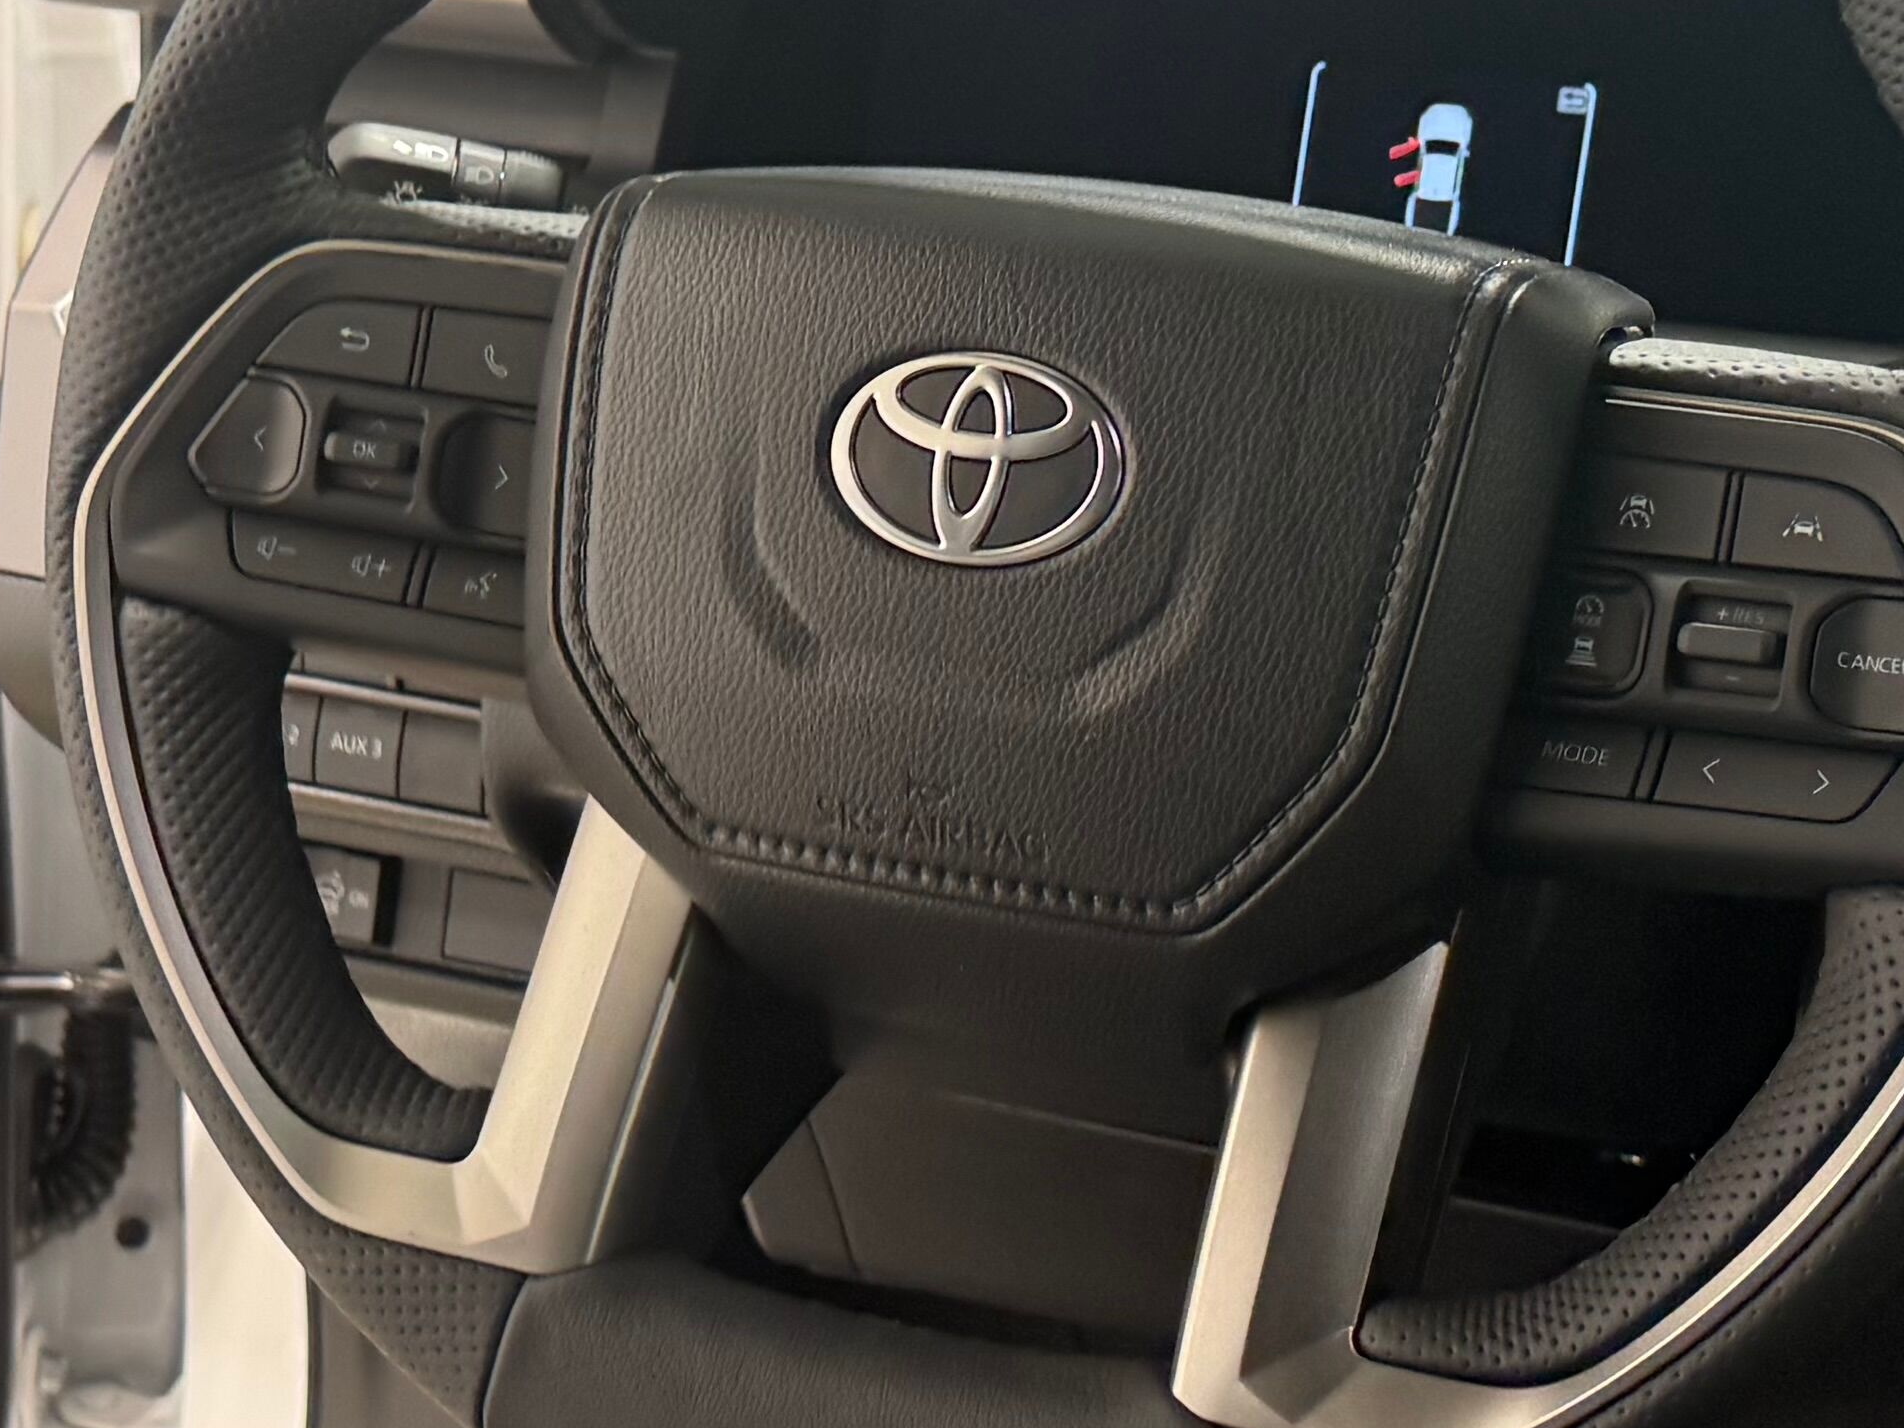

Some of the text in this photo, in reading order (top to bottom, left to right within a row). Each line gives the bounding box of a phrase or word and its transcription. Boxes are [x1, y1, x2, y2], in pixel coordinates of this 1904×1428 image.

[352, 439, 376, 460] OK
[330, 731, 368, 756] AUX
[1542, 740, 1610, 766] MODE
